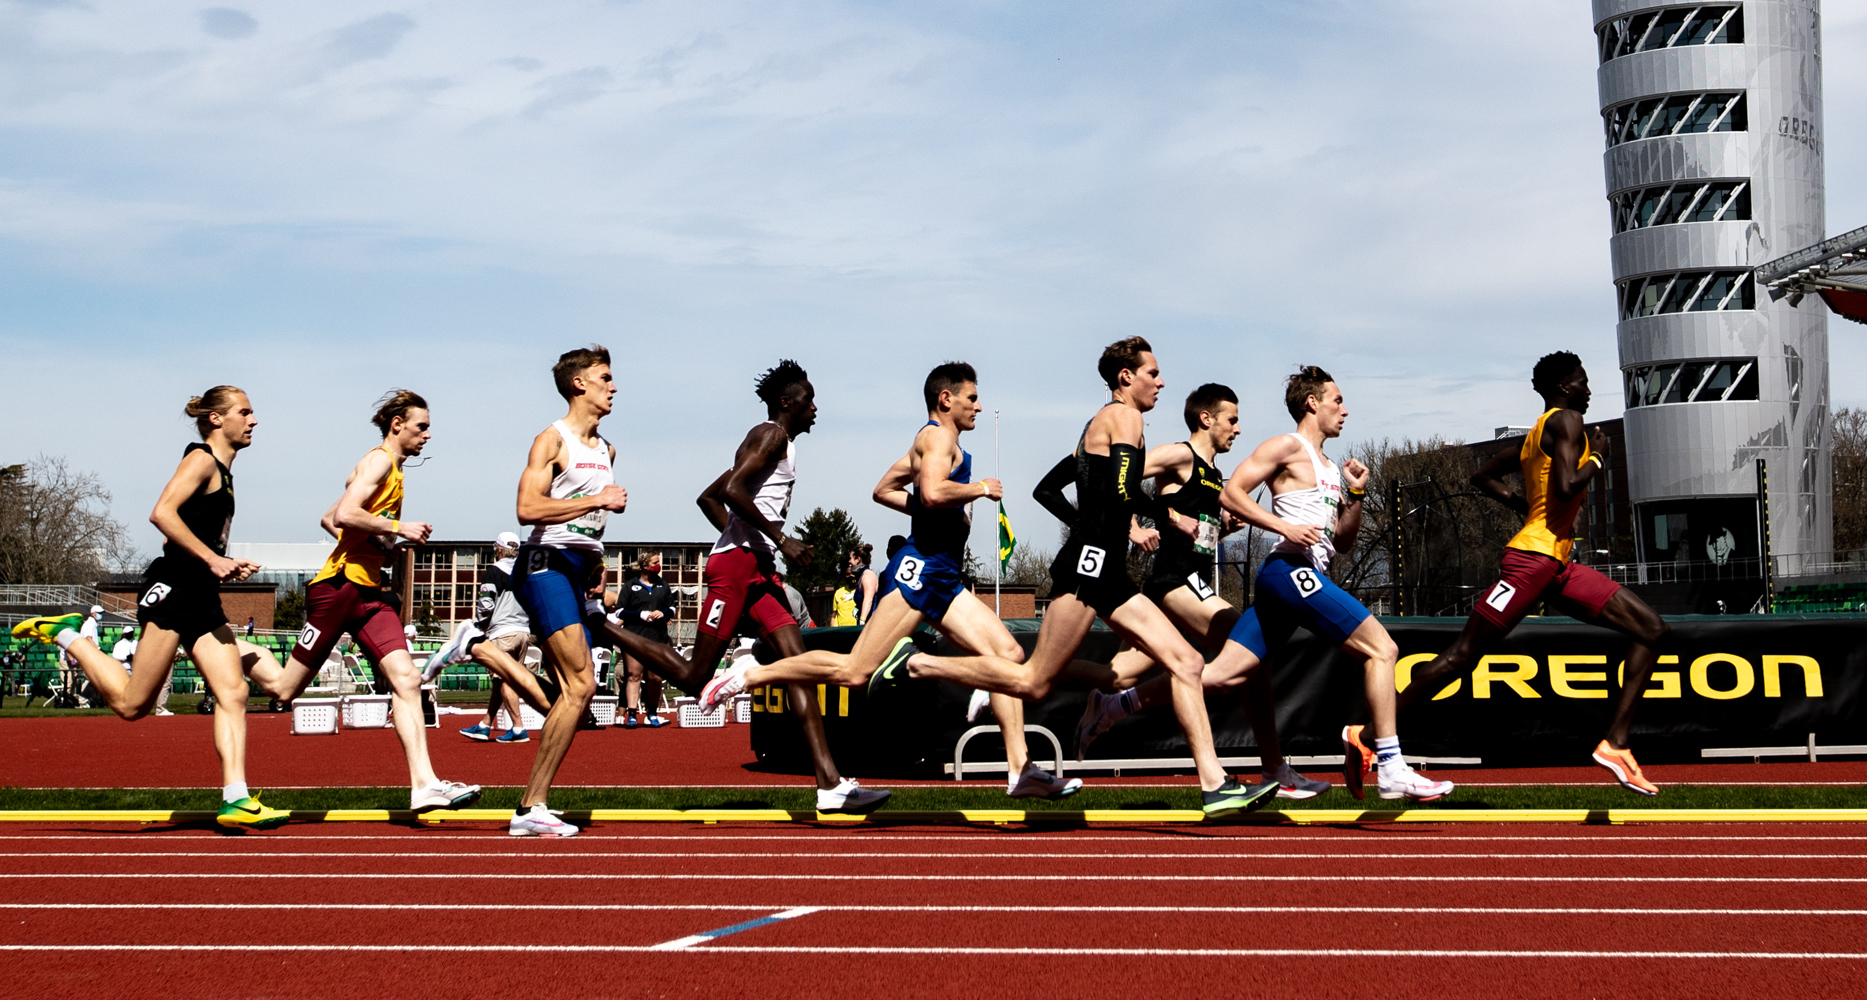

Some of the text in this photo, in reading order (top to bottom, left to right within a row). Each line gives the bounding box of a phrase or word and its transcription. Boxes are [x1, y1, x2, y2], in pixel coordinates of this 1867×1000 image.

[530, 550, 546, 571] 9
[900, 559, 917, 582] 3
[1081, 549, 1100, 573] 5
[1196, 573, 1211, 591] 4
[1296, 570, 1315, 592] 8
[145, 585, 164, 607] 6
[1491, 583, 1511, 603] 7
[1394, 653, 1824, 701] OREGON
